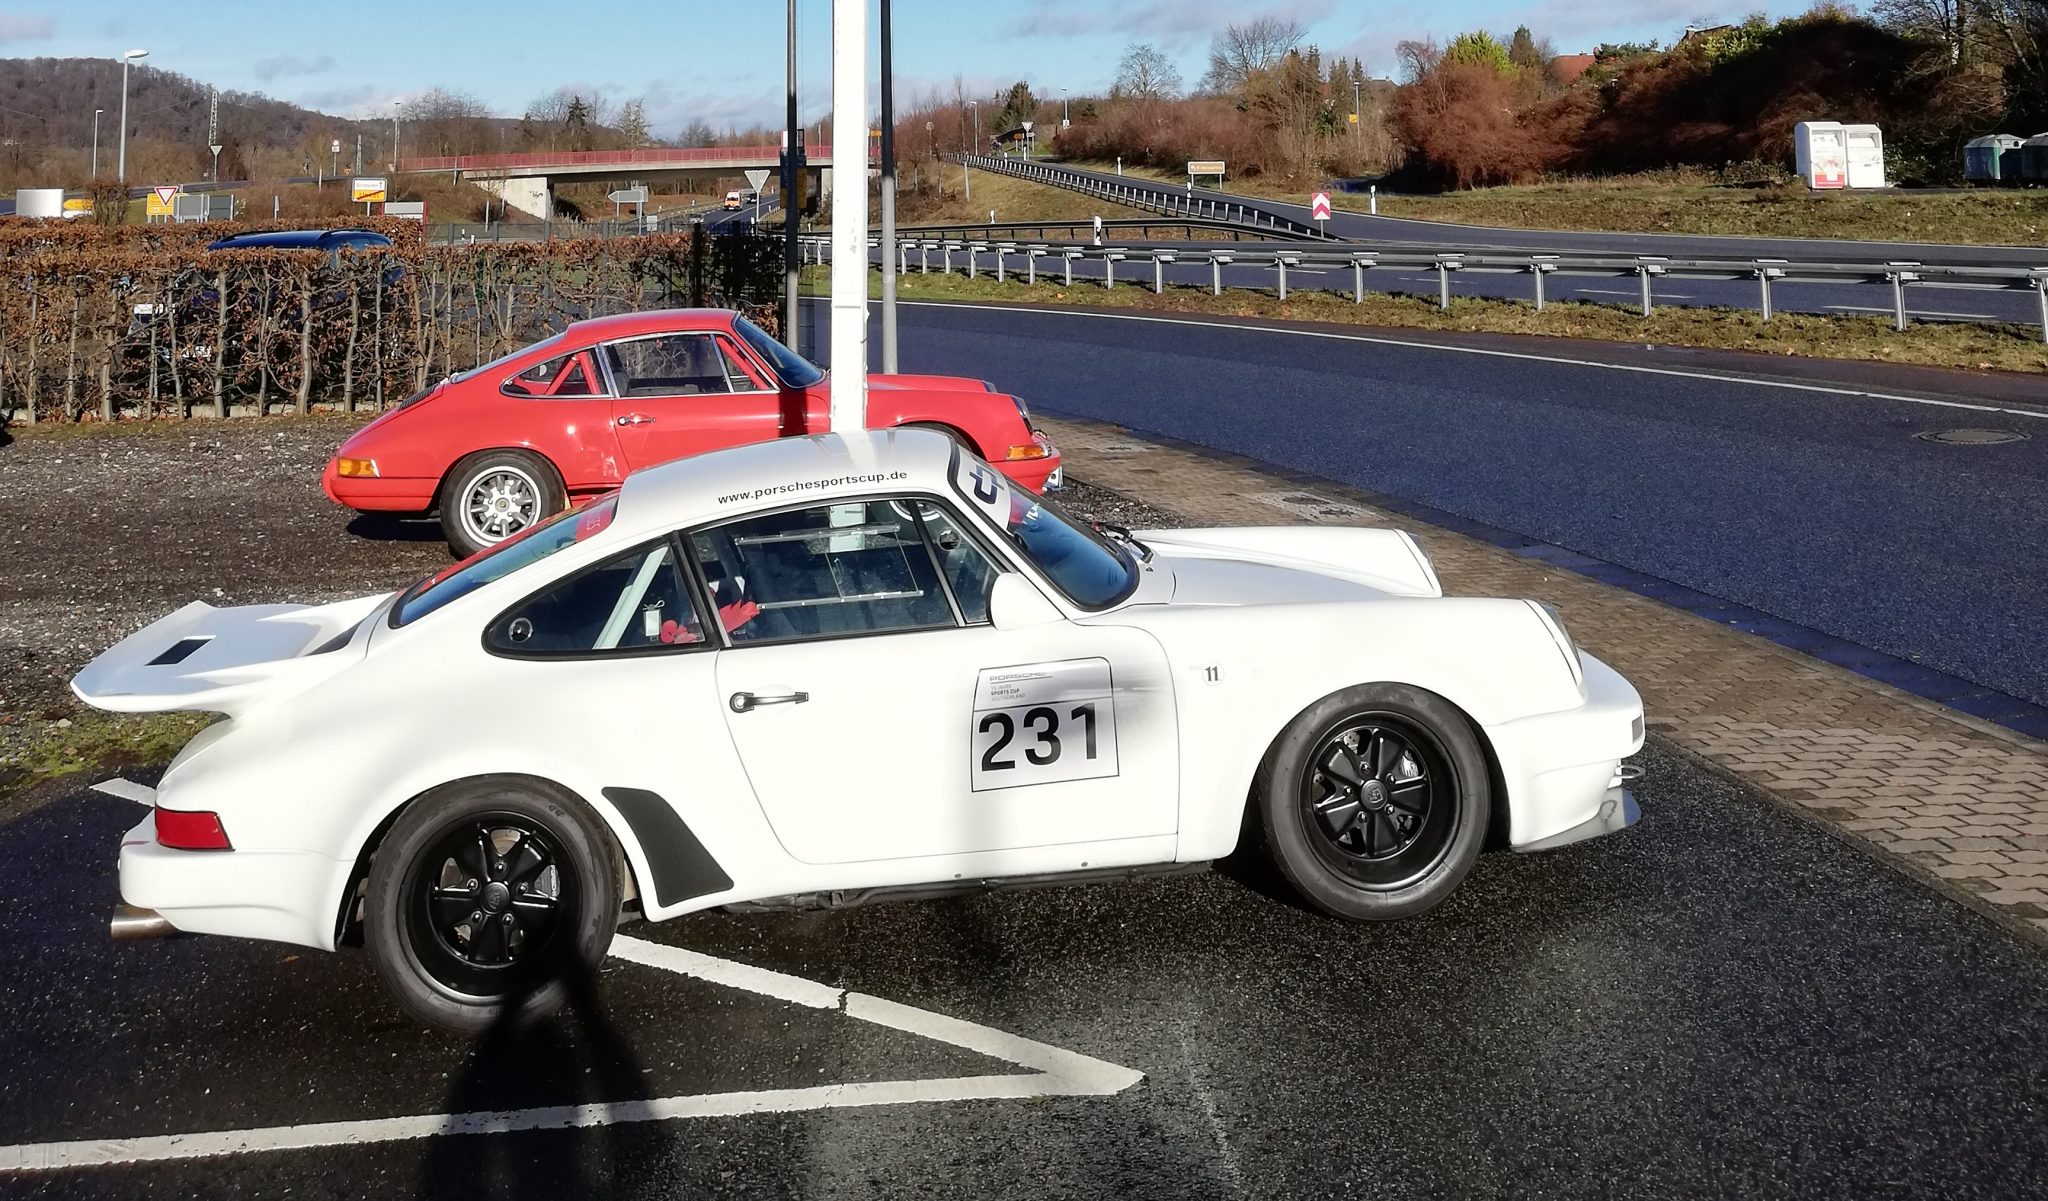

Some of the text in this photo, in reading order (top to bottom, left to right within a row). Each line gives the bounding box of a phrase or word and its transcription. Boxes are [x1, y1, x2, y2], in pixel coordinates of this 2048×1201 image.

[718, 471, 908, 504] www.porschesportscup.de
[1204, 665, 1219, 682] 11
[979, 703, 1096, 771] 231
